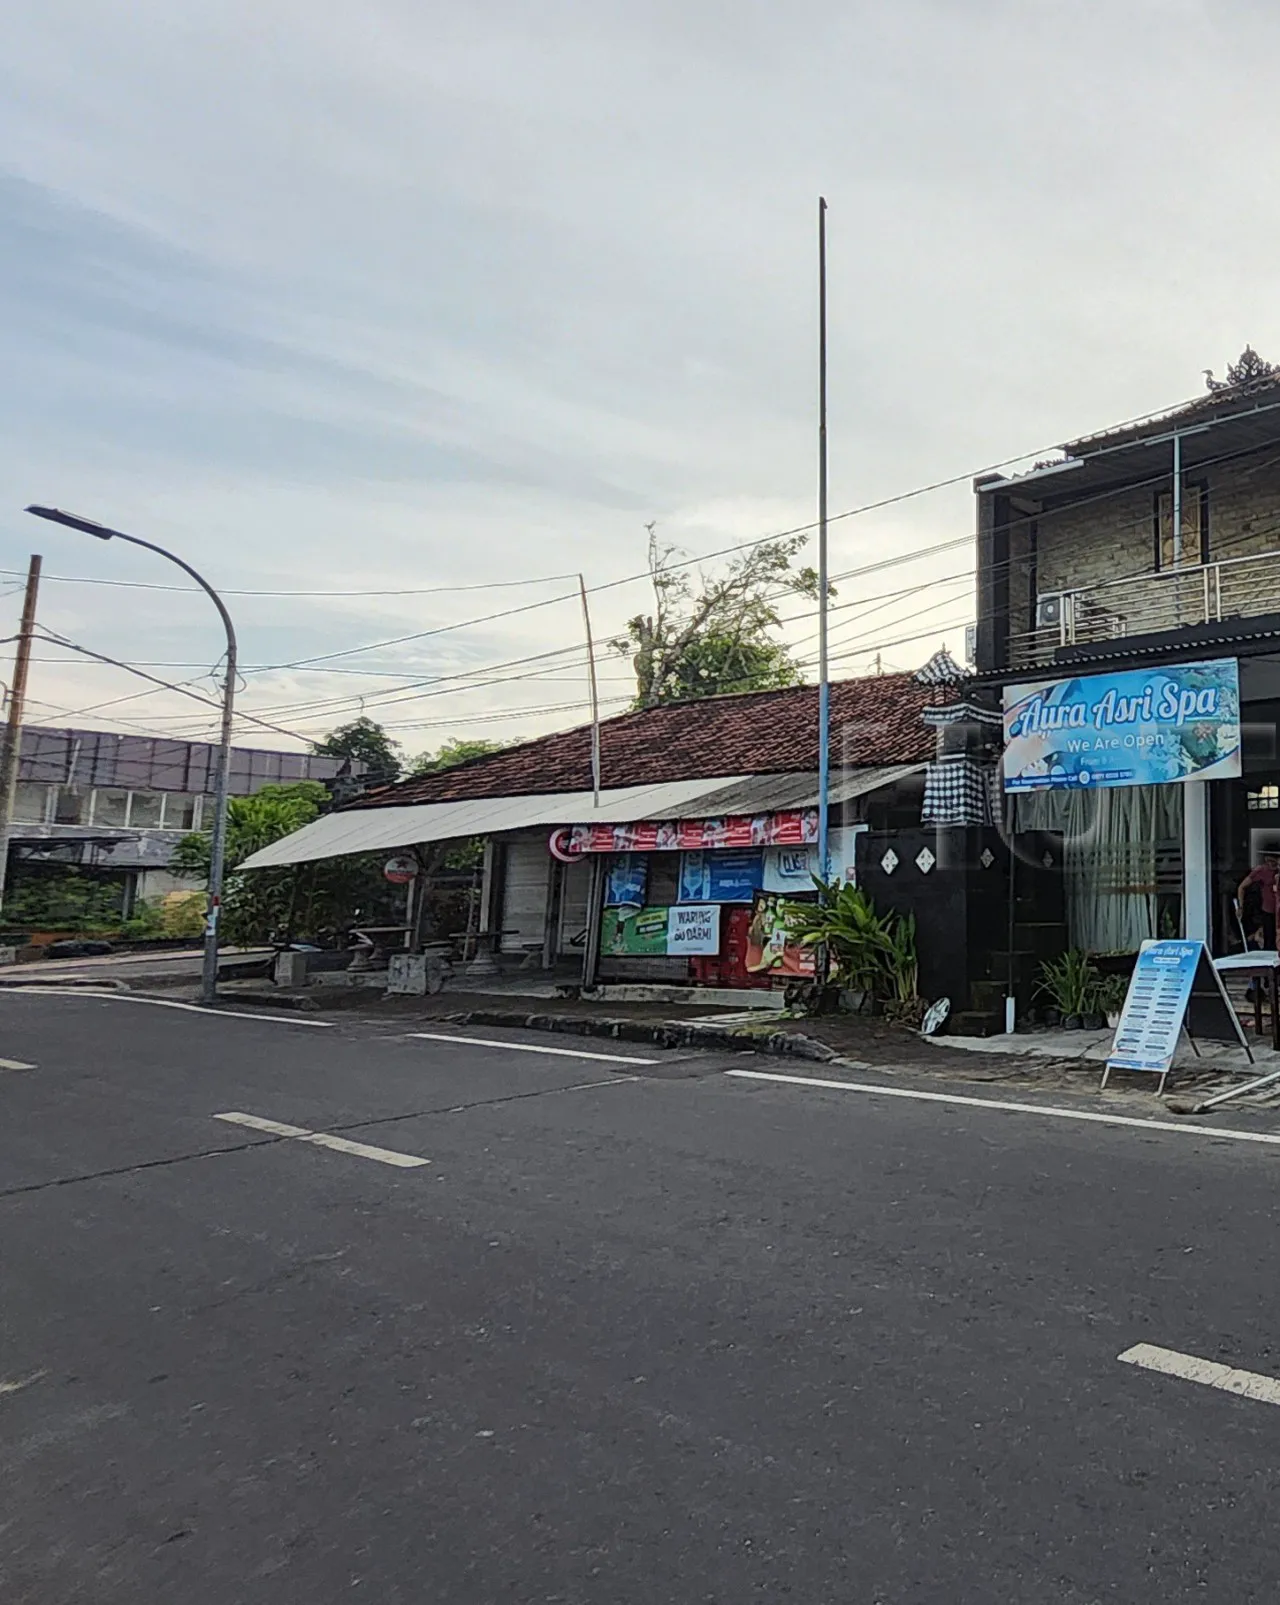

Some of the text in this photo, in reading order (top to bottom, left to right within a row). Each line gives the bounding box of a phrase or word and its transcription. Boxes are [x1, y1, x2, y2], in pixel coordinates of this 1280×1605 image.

[1014, 681, 1217, 737] Aura Asri Spa
[1067, 734, 1164, 752] We Are Open
